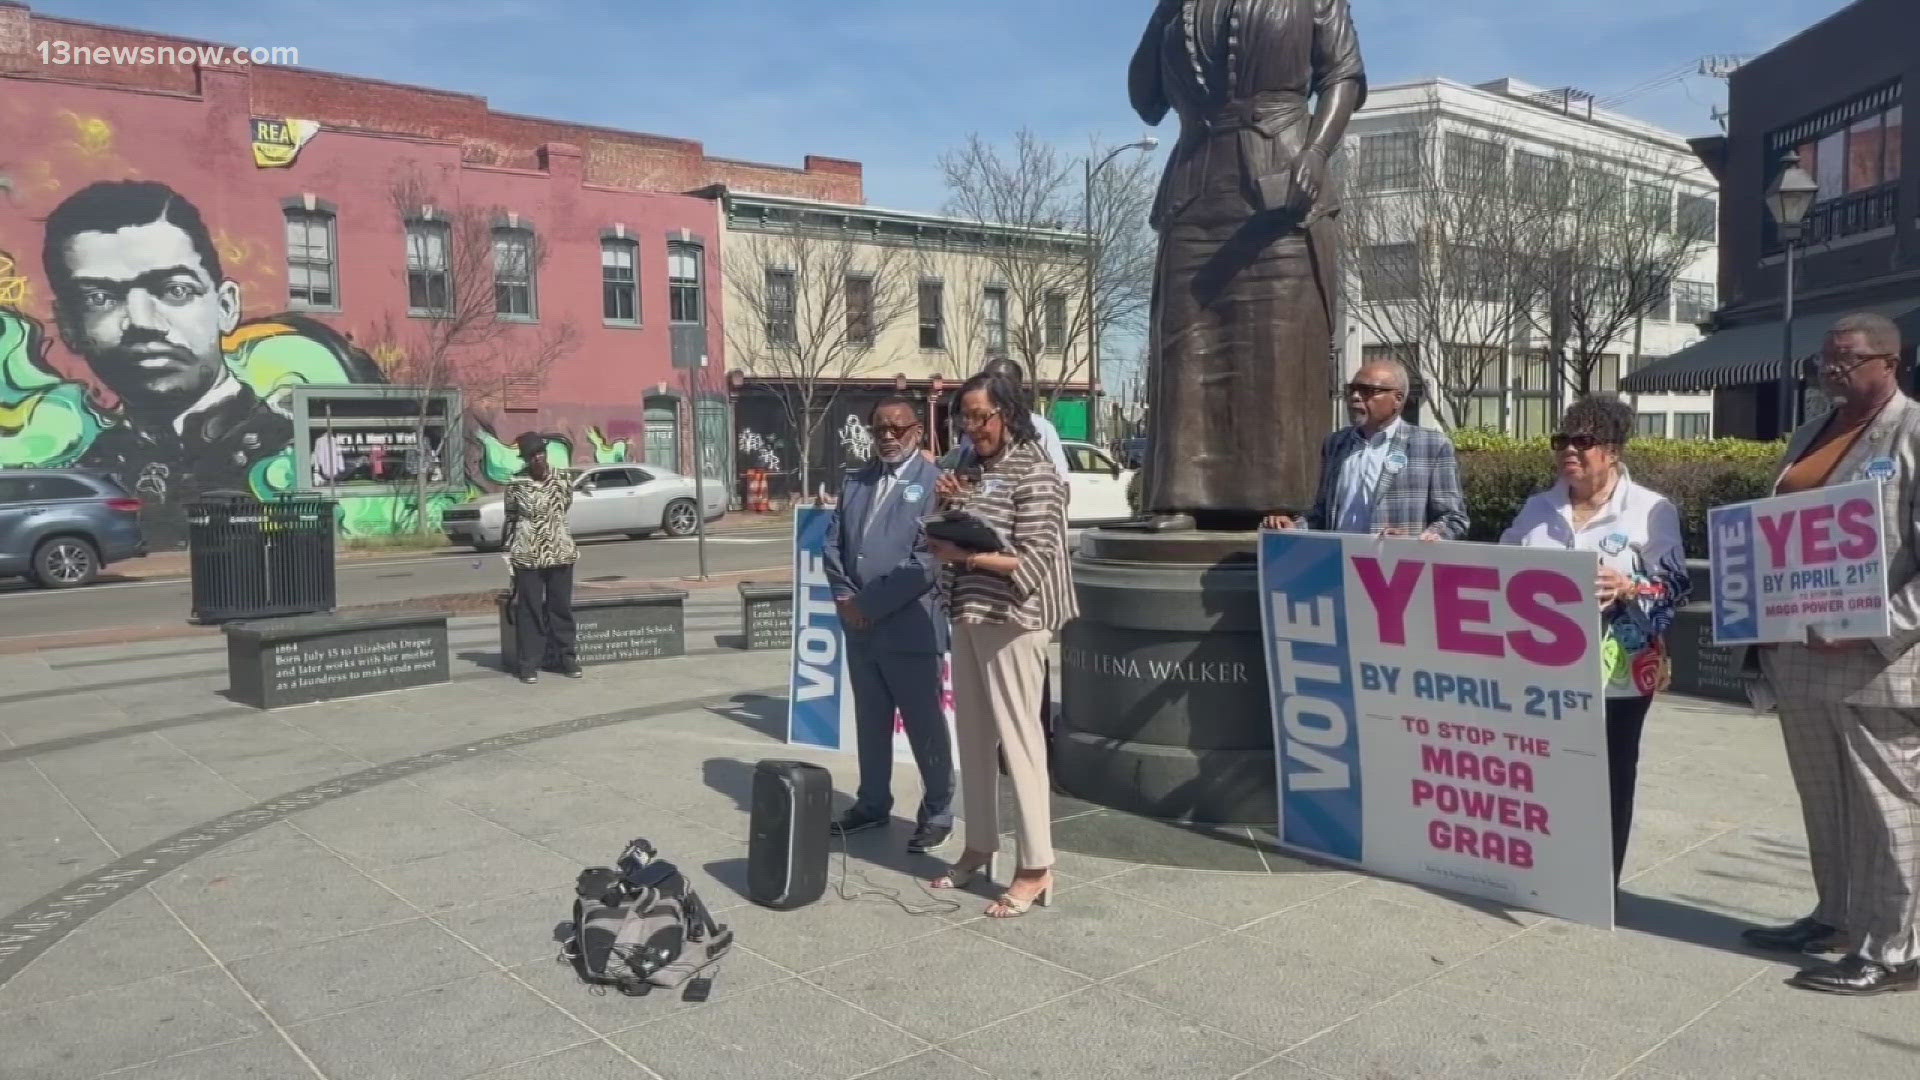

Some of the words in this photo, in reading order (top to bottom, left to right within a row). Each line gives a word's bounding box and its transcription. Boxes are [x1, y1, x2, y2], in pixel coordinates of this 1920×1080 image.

[1757, 498, 1878, 570] YES
[1718, 521, 1749, 626] VOTE
[1763, 575, 1784, 593] BY
[1791, 567, 1840, 590] APRIL
[1845, 561, 1879, 585] 21ST
[796, 550, 839, 702] VOTE
[1350, 556, 1588, 667] YES
[1765, 604, 1798, 618] MAGA
[1802, 600, 1844, 614] POWER
[1848, 596, 1881, 610] GRAB
[275, 654, 300, 665] Born
[303, 650, 324, 663] July
[341, 647, 351, 656] to
[354, 640, 397, 655] Elizabeth
[400, 637, 431, 650] Draper
[612, 627, 644, 638] Normal
[275, 666, 296, 678] and
[300, 663, 322, 674] later
[325, 658, 355, 671] works
[358, 655, 381, 667] with
[383, 652, 398, 662] her
[401, 648, 434, 660] mother
[275, 681, 287, 690] as
[300, 673, 347, 687] laundress
[350, 670, 360, 680] to
[363, 666, 388, 678] make
[390, 662, 412, 673] ends
[414, 659, 436, 671] meet
[1094, 653, 1140, 679] LENA
[1149, 659, 1249, 683] WALKER
[1271, 590, 1350, 791] VOTE
[1360, 661, 1400, 695] BY
[1413, 670, 1512, 712] APRIL
[1524, 685, 1593, 720] 21ST
[1401, 715, 1430, 735] TO
[1438, 721, 1496, 746] STOP
[1503, 732, 1551, 757] THE
[1421, 743, 1534, 793] MAGA
[1411, 778, 1551, 836] POWER
[1429, 820, 1534, 870] GRAB
